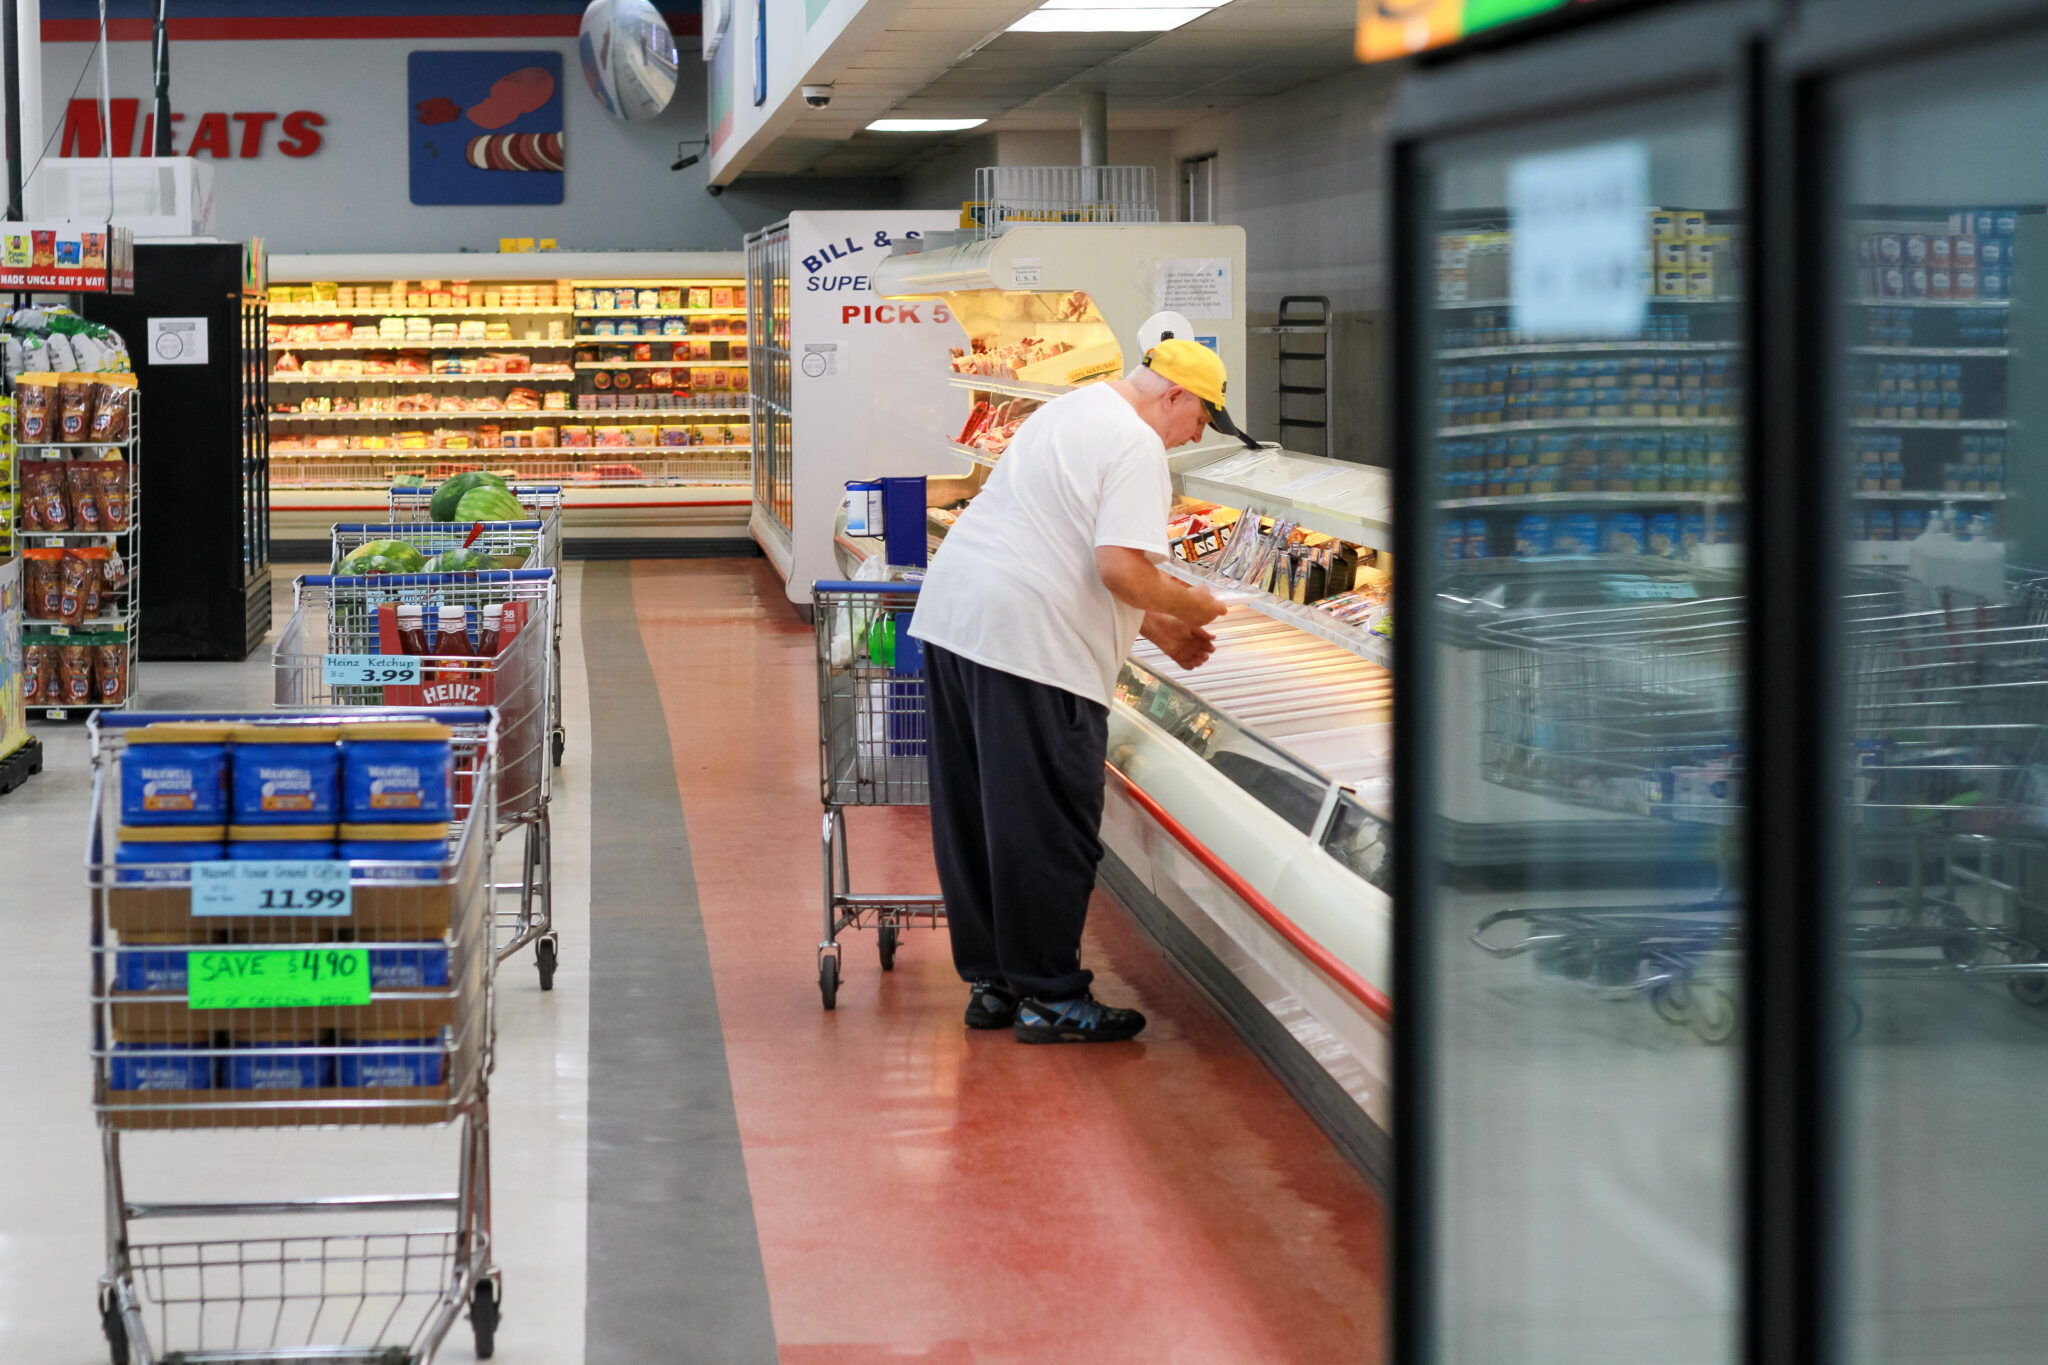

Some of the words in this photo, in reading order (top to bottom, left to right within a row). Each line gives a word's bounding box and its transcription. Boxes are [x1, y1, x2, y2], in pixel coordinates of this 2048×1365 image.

[60, 97, 325, 158] MEATS
[801, 236, 864, 274] BILL
[873, 230, 892, 248] &
[0, 274, 24, 285] MADE
[27, 275, 56, 285] UNCLE
[58, 275, 83, 286] RAY'S
[85, 277, 105, 287] WAY!
[806, 275, 872, 291] SUPE
[842, 304, 921, 325] PICK
[933, 304, 950, 324] 5
[503, 610, 515, 619] 38
[328, 658, 360, 667] Heinz
[368, 658, 414, 669] Ketchup
[361, 669, 414, 682] 3.99
[423, 683, 481, 704] HEINZ
[258, 888, 346, 909] 11.99
[201, 954, 266, 982] SAVE
